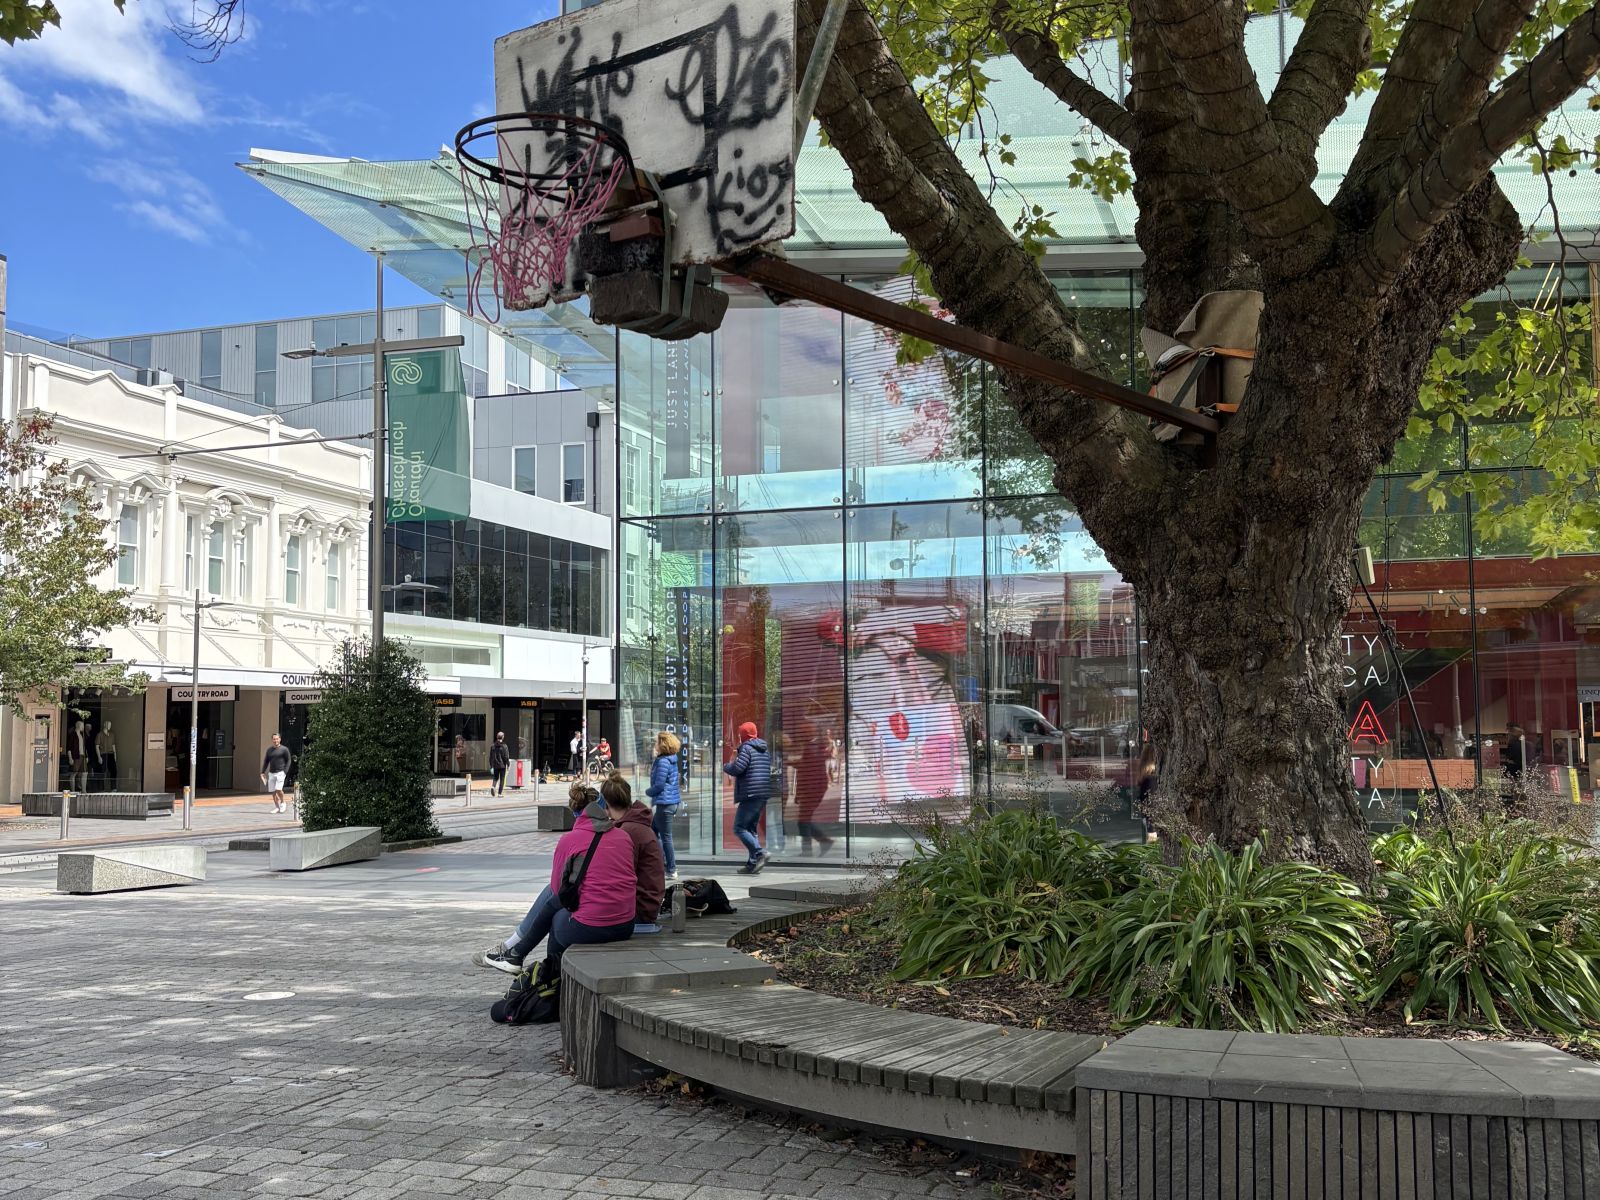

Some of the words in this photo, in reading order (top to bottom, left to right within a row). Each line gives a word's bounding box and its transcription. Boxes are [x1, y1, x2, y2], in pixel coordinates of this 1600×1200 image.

[666, 591, 677, 635] LOOP
[177, 690, 210, 698] COUTRY
[665, 644, 677, 709] BEAUTY
